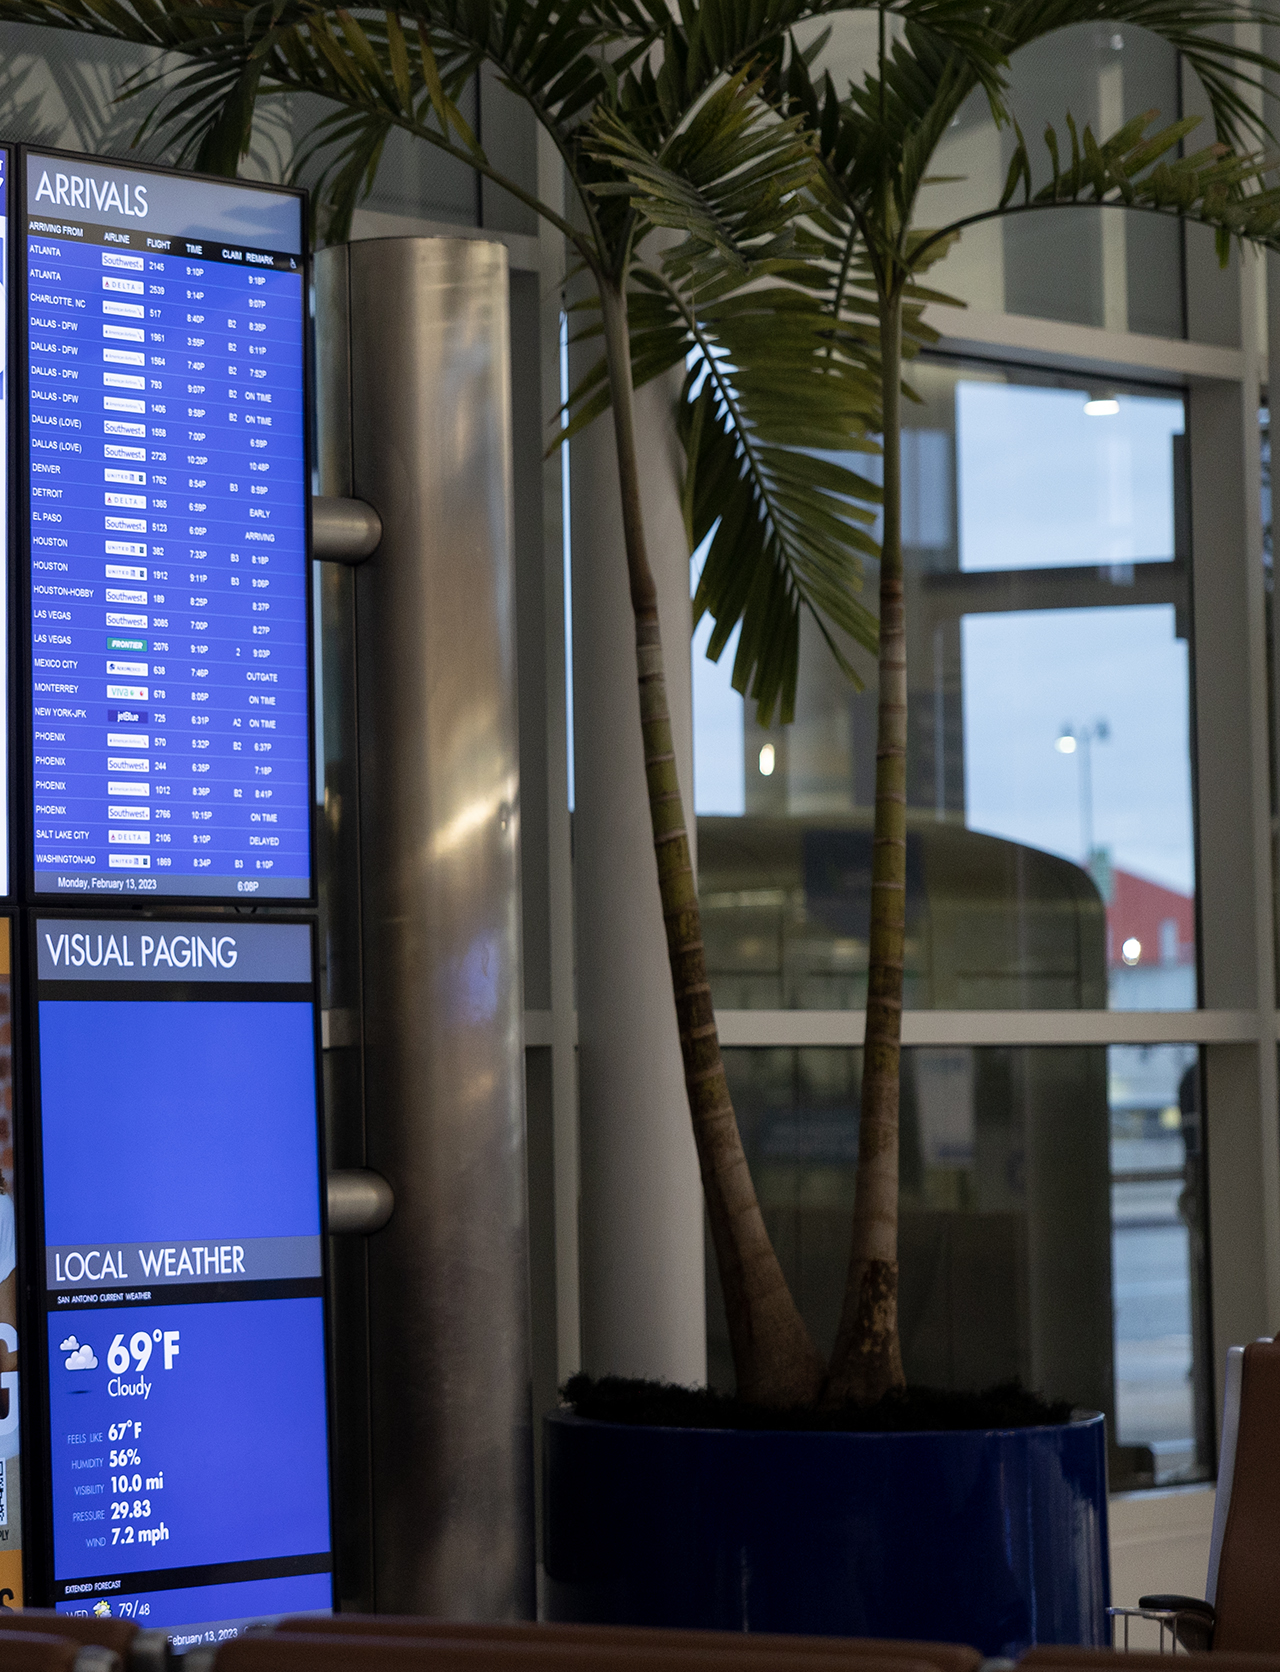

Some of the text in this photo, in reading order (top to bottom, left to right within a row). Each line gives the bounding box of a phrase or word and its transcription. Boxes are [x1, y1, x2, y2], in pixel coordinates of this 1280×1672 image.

[36, 170, 148, 217] ARRIVALS
[29, 221, 273, 266] ARRIVING FROM AIRLINE FLIGHT TIME CLAIM REMARK
[30, 245, 61, 256] ATLANTA
[33, 512, 62, 522] EL PASO
[34, 586, 94, 598] HOUSTON-HOBBY
[34, 658, 78, 668] MEXICO CITY
[35, 708, 86, 718] NEW YORK-JFK
[58, 877, 258, 892] Monday, February 13, 2023 6:08P
[45, 934, 238, 968] VISUAL PAGING
[56, 1245, 246, 1282] LOCAL WEATHER
[107, 1328, 180, 1374] 69°F
[107, 1376, 152, 1399] Cloudy
[67, 1432, 103, 1444] FEELS LIKE
[71, 1448, 141, 1470] HUMIDITY 56%
[74, 1472, 164, 1495] VISIBILITY 10.0 mi
[72, 1499, 151, 1521] PRESSURE 29.83
[86, 1522, 169, 1548] WIND 7.2 mph
[65, 1581, 121, 1594] EXTENDED FORECAST
[119, 1602, 150, 1617] 79/48
